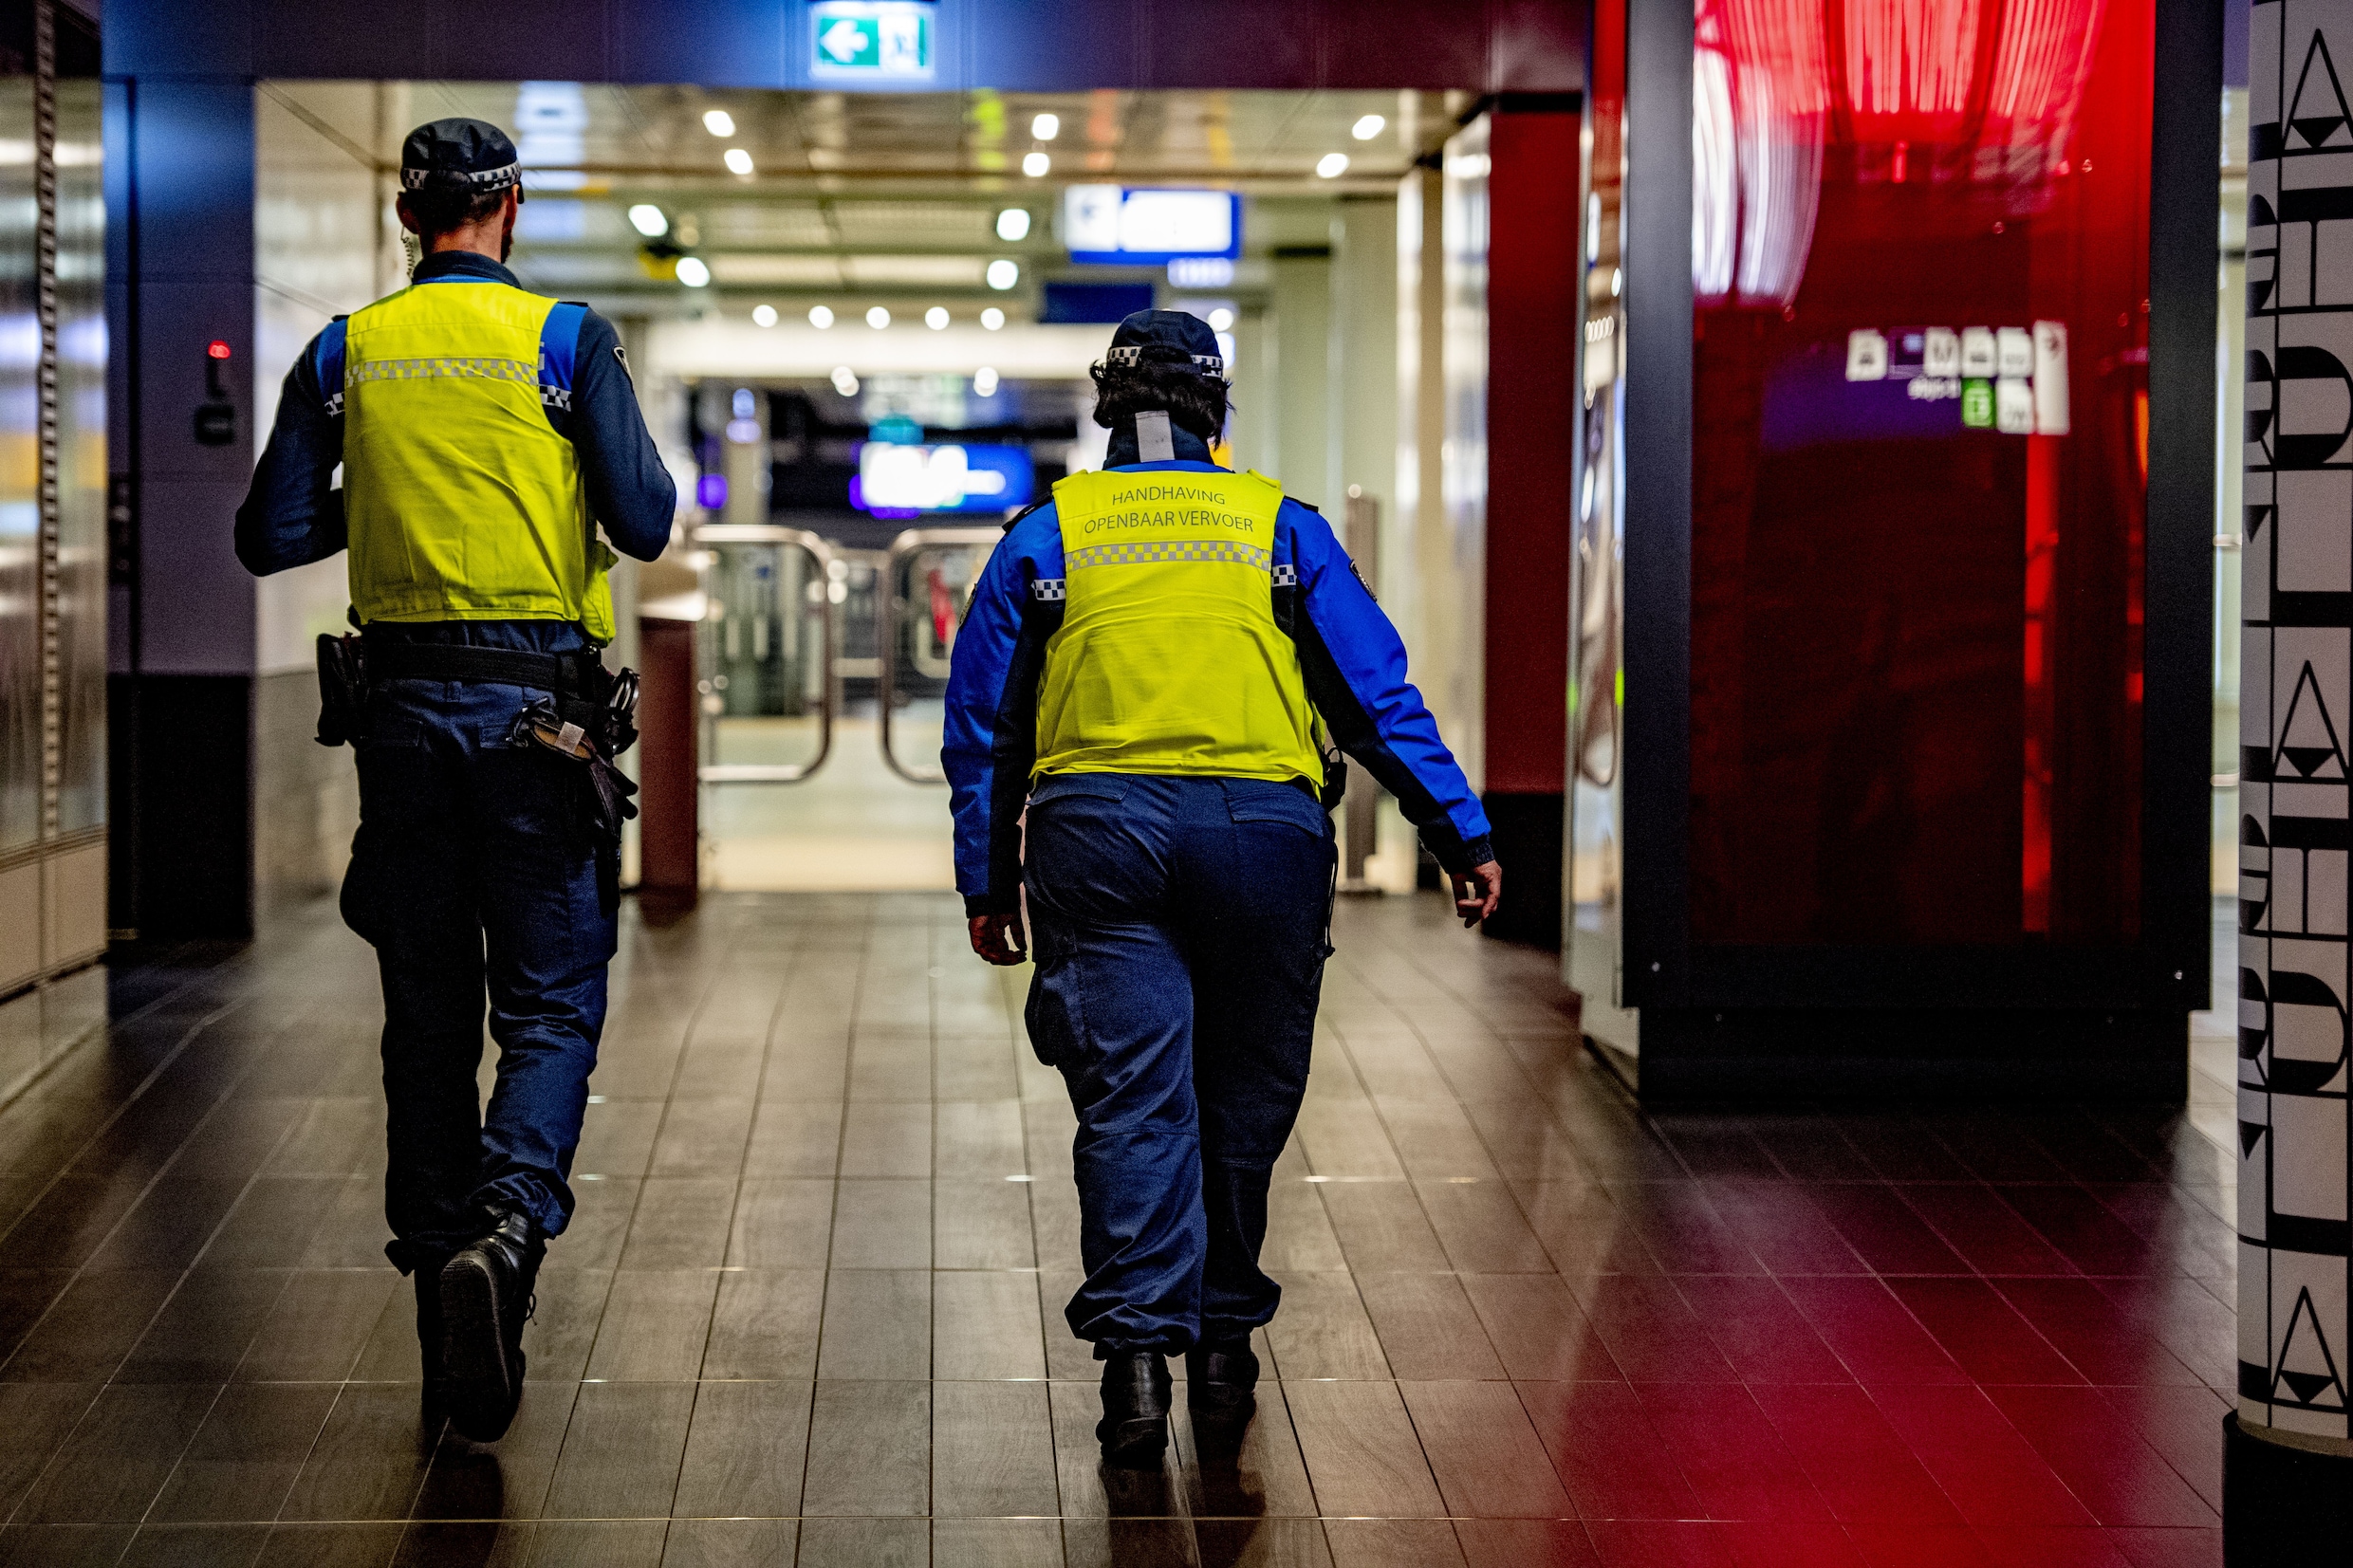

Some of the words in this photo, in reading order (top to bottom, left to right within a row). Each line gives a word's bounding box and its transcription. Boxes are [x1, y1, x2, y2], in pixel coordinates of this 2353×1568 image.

[1112, 486, 1226, 506] HANDHAVING
[1084, 510, 1175, 534] OPENBAAR
[1178, 510, 1254, 533] VERVOER
